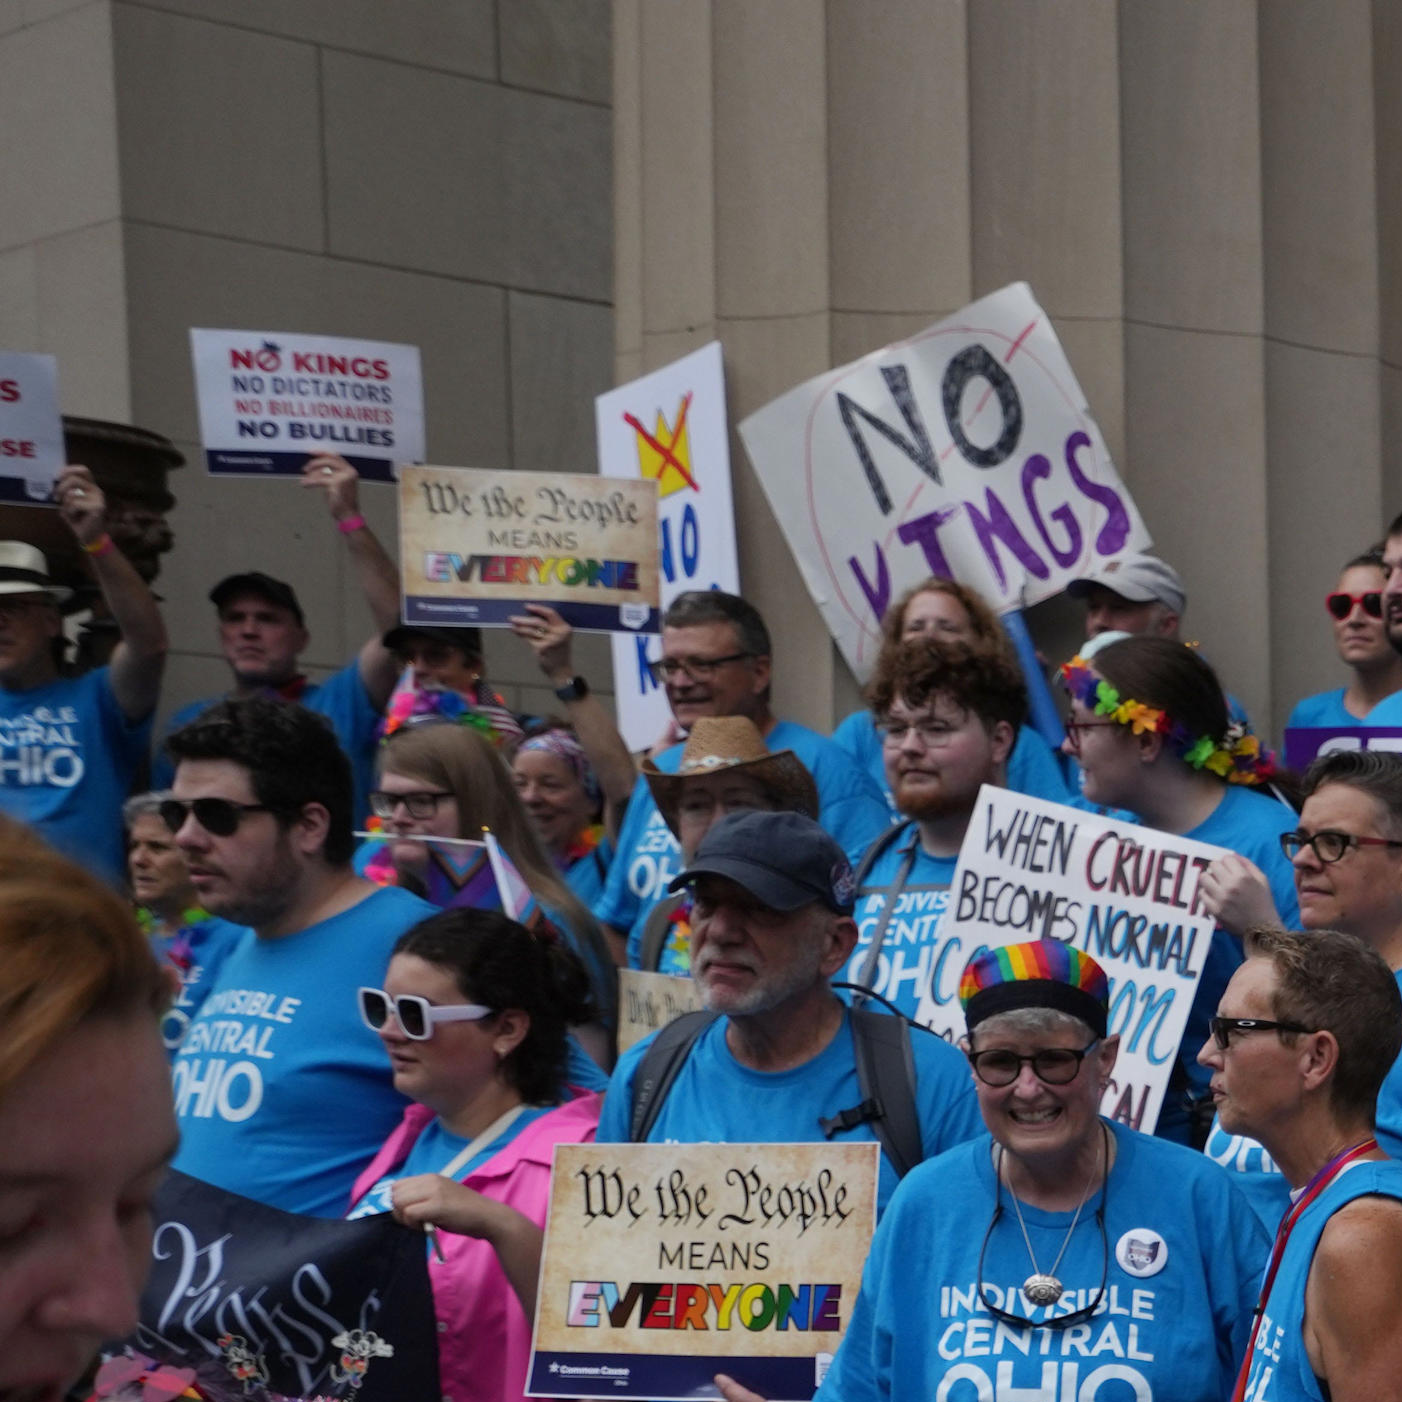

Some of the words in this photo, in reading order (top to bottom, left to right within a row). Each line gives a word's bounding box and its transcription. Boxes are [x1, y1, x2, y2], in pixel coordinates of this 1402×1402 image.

[229, 349, 281, 373] NO
[293, 351, 390, 381] KINGS
[232, 375, 264, 395] NO
[272, 377, 392, 405] DICTATORS
[235, 400, 262, 415] NO
[268, 400, 393, 425] BILLIONAIRES
[837, 344, 1023, 516] NO
[238, 420, 279, 440] NO
[289, 422, 395, 447] BULLIES
[420, 481, 474, 517] We
[481, 485, 526, 517] the
[534, 484, 640, 530] People
[487, 529, 579, 551] MEANS
[425, 553, 640, 591] EVERYONE
[984, 804, 1077, 876] WHEN
[1084, 830, 1214, 920] CRUELT
[956, 869, 1082, 944] BECOMES
[1082, 904, 1198, 980] NORMAL
[574, 1164, 649, 1229] We
[654, 1168, 717, 1228] the
[718, 1164, 854, 1240] People
[658, 1242, 771, 1271] MEANS
[566, 1280, 843, 1332] EVERYONE
[938, 1320, 1155, 1362] CENTRAL
